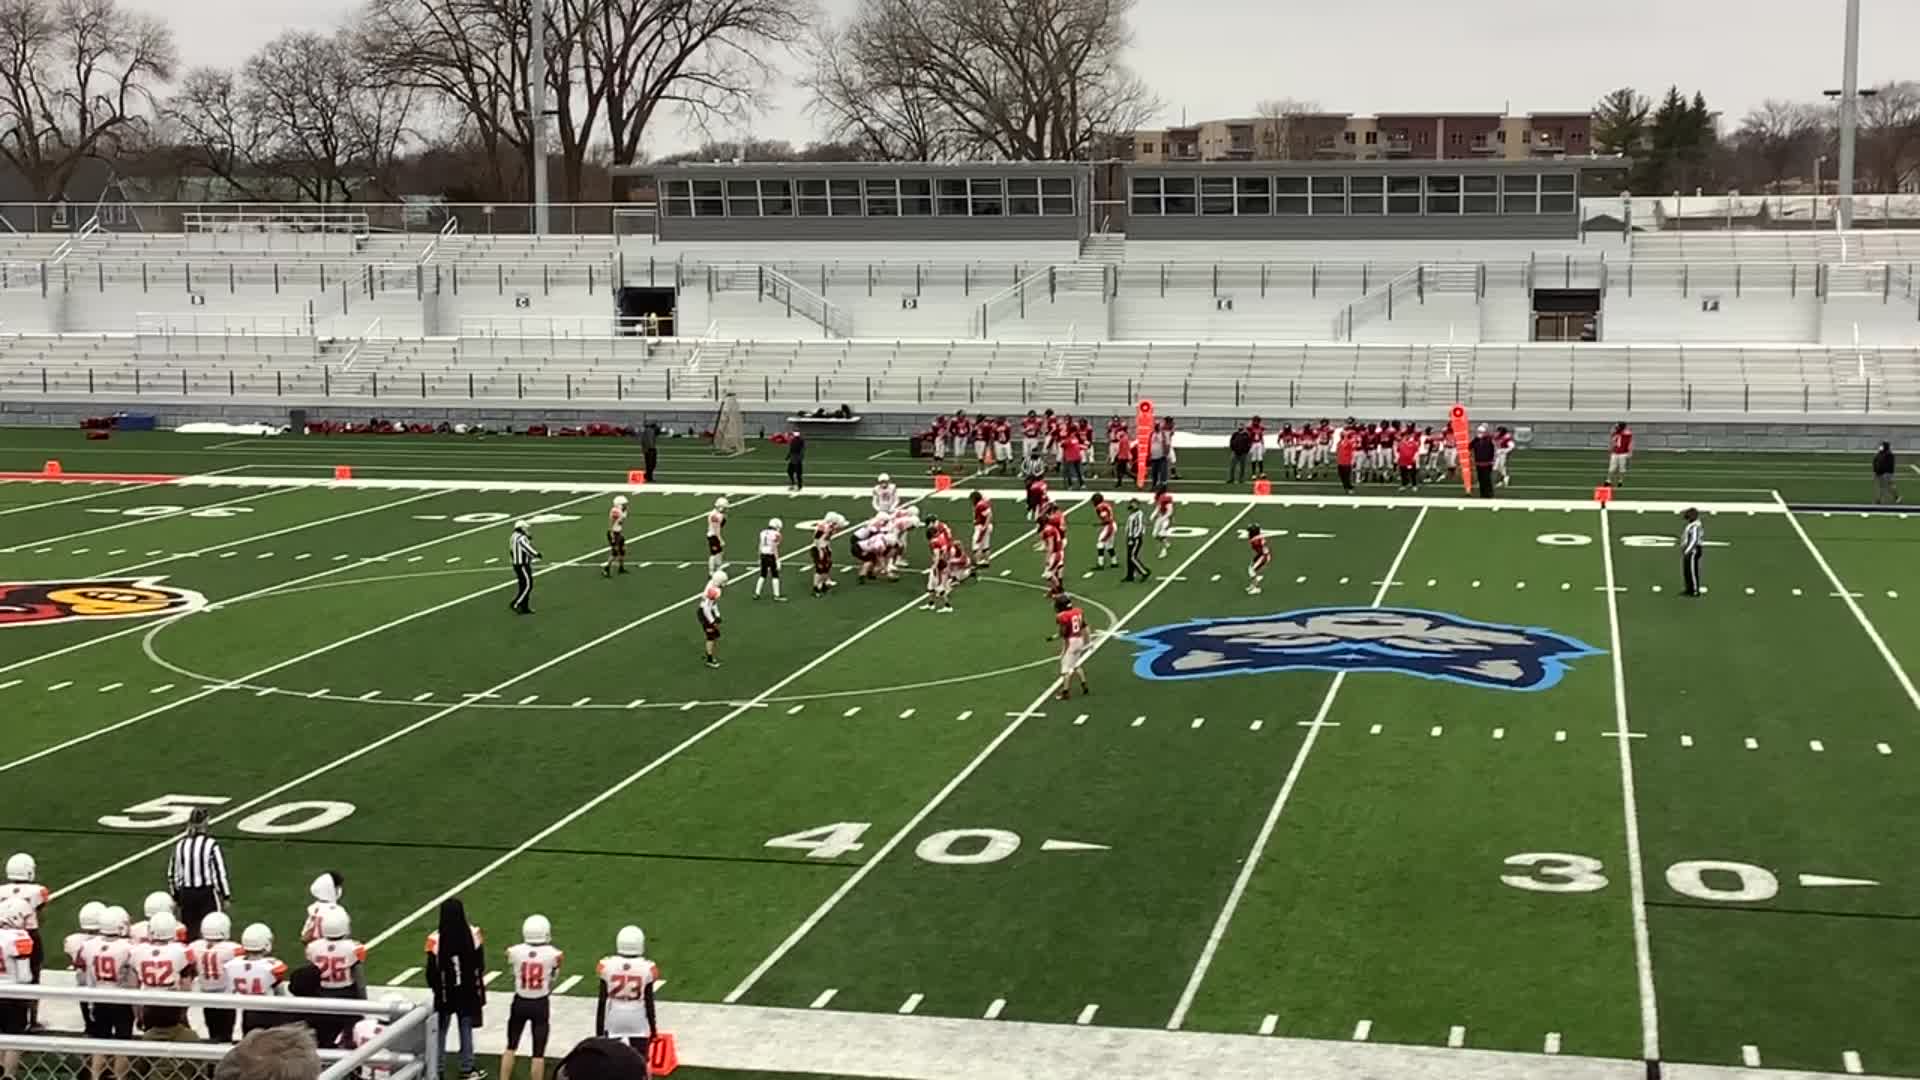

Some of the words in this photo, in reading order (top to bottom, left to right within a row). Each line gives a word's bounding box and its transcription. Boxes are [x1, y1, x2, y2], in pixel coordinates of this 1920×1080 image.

[97, 793, 356, 834] 50
[763, 822, 1021, 864] 40
[1500, 853, 1778, 902] 30
[93, 956, 118, 982] 19
[141, 960, 174, 986] 62
[204, 952, 220, 980] 11
[316, 956, 347, 983] 26
[521, 961, 545, 990] 18
[610, 974, 643, 1001] 23
